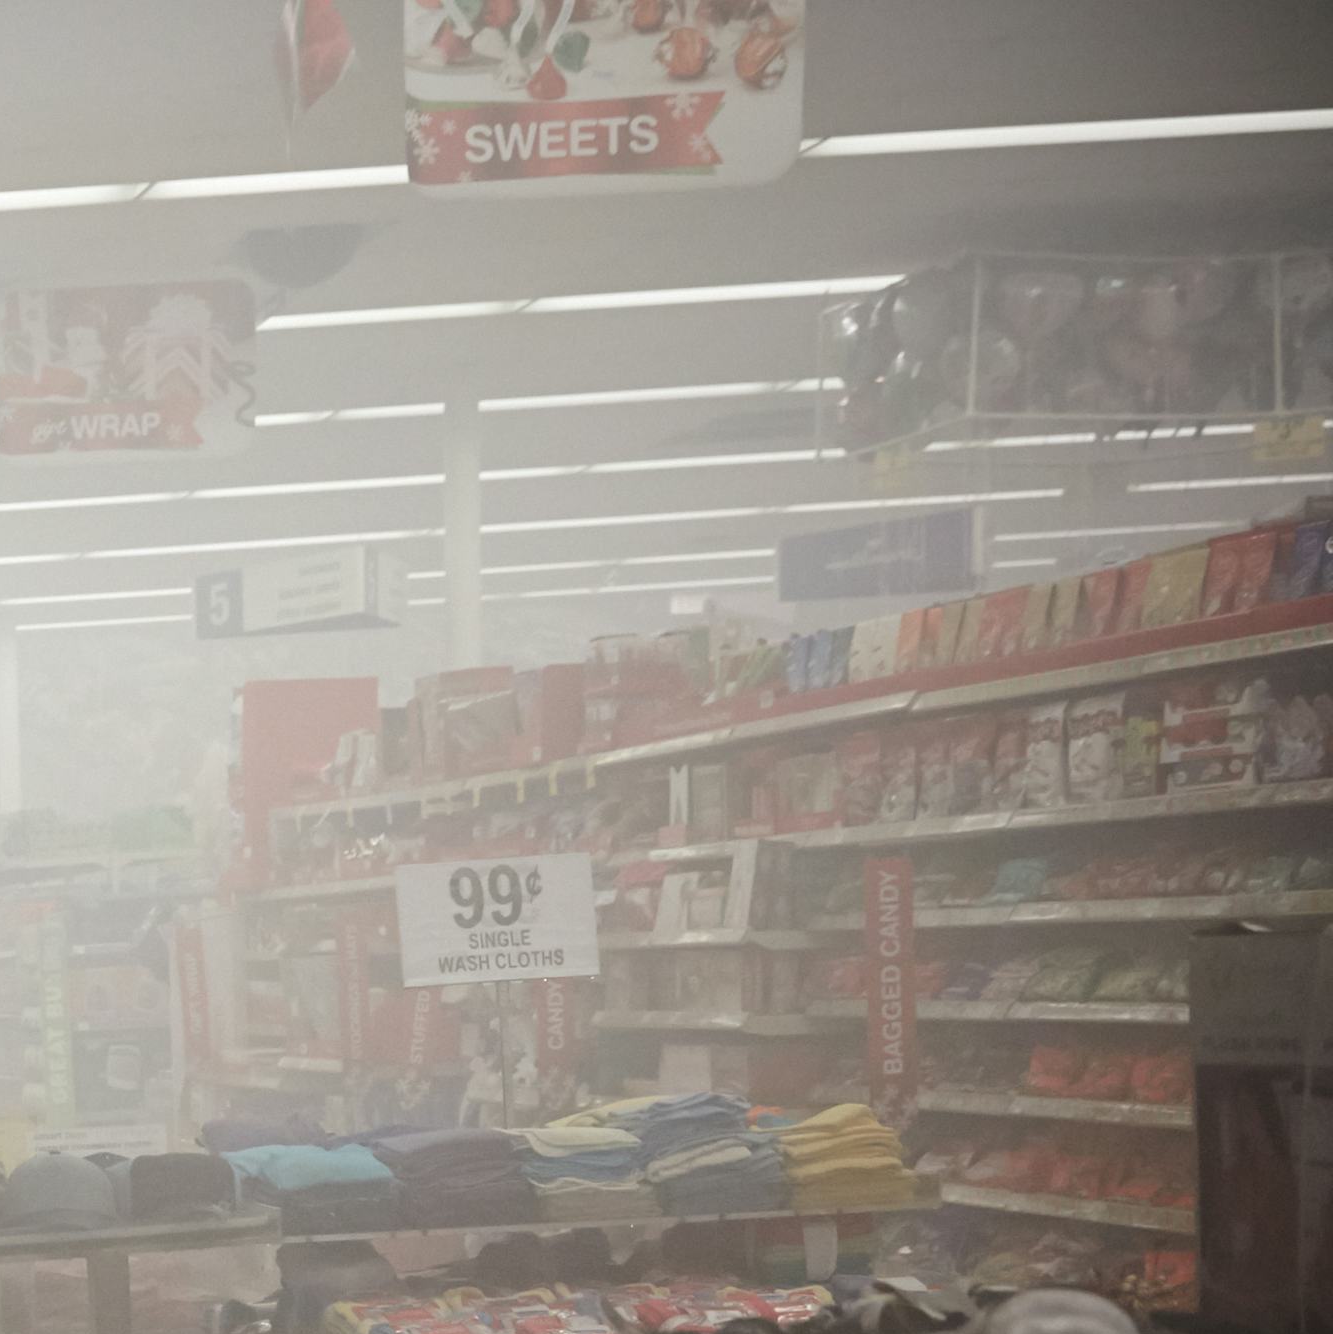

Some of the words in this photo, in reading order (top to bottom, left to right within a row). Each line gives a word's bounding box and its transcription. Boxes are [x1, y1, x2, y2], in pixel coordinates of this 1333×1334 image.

[464, 115, 659, 162] SWEETS
[70, 412, 161, 440] WRAP
[209, 582, 231, 627] 5
[878, 869, 902, 959] CANDY
[437, 954, 491, 974] WASH
[494, 948, 565, 970] CLOTHS
[467, 929, 532, 950] SINGLE
[410, 990, 431, 1065] STUFFED
[547, 980, 565, 1051] CANDY
[880, 964, 904, 1076] BAGGED
